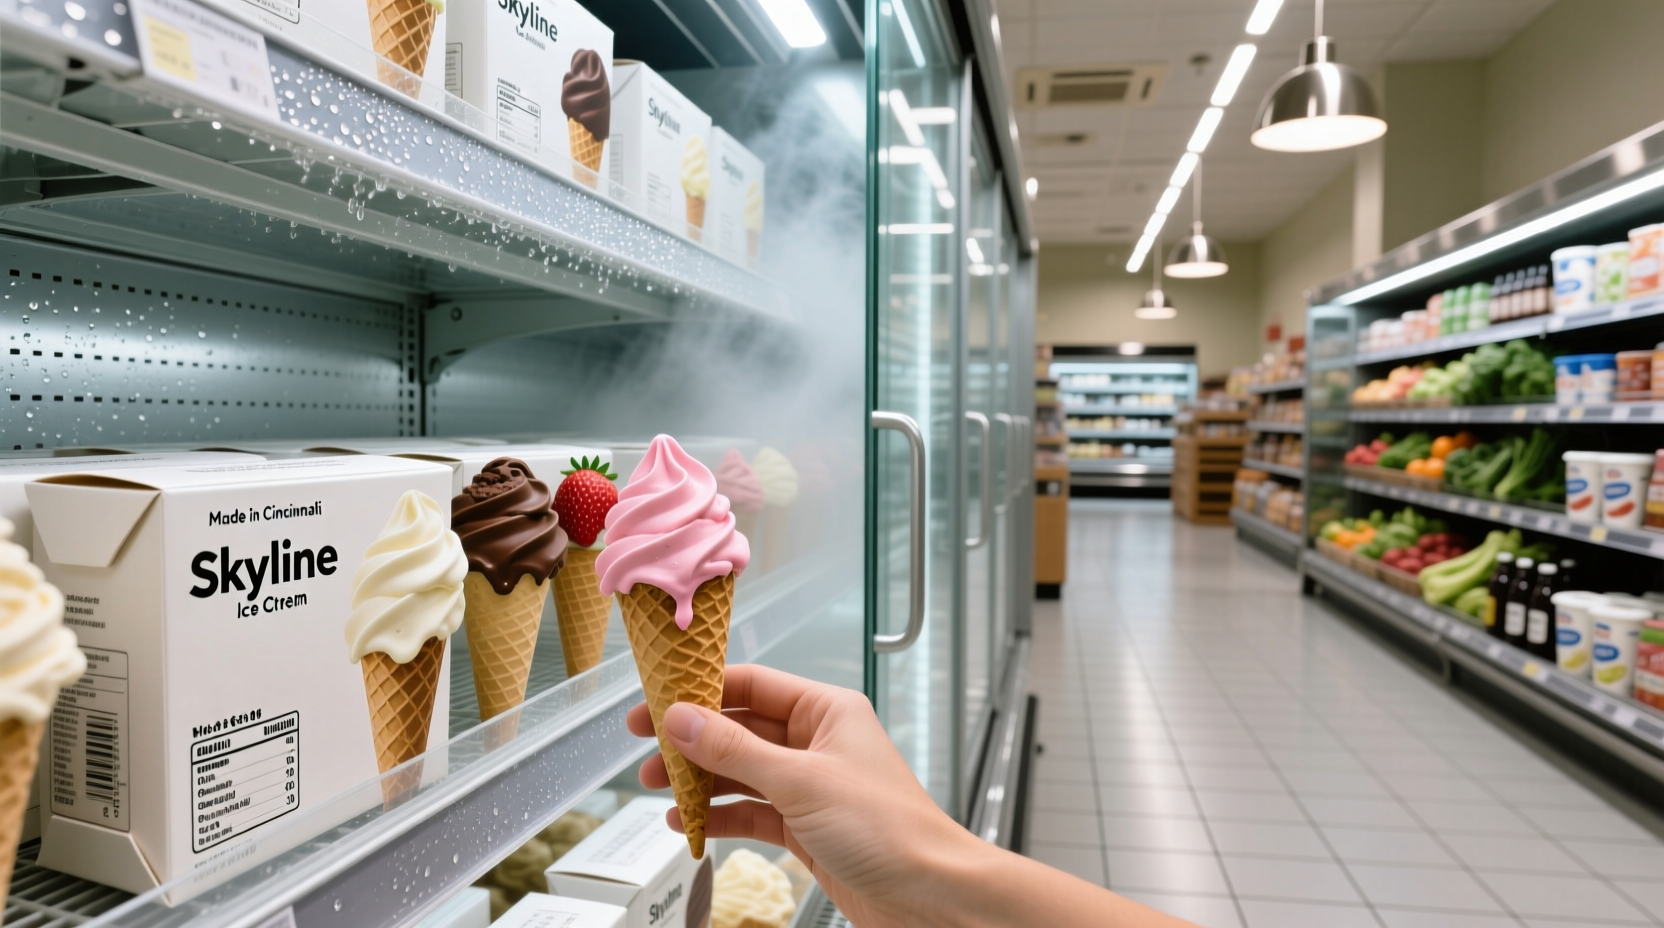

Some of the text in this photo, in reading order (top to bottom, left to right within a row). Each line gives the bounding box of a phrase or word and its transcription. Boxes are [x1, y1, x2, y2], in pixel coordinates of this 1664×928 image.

[209, 508, 246, 526] Made
[250, 507, 260, 522] in
[189, 538, 338, 601] Skyline
[237, 602, 259, 618] Ice
